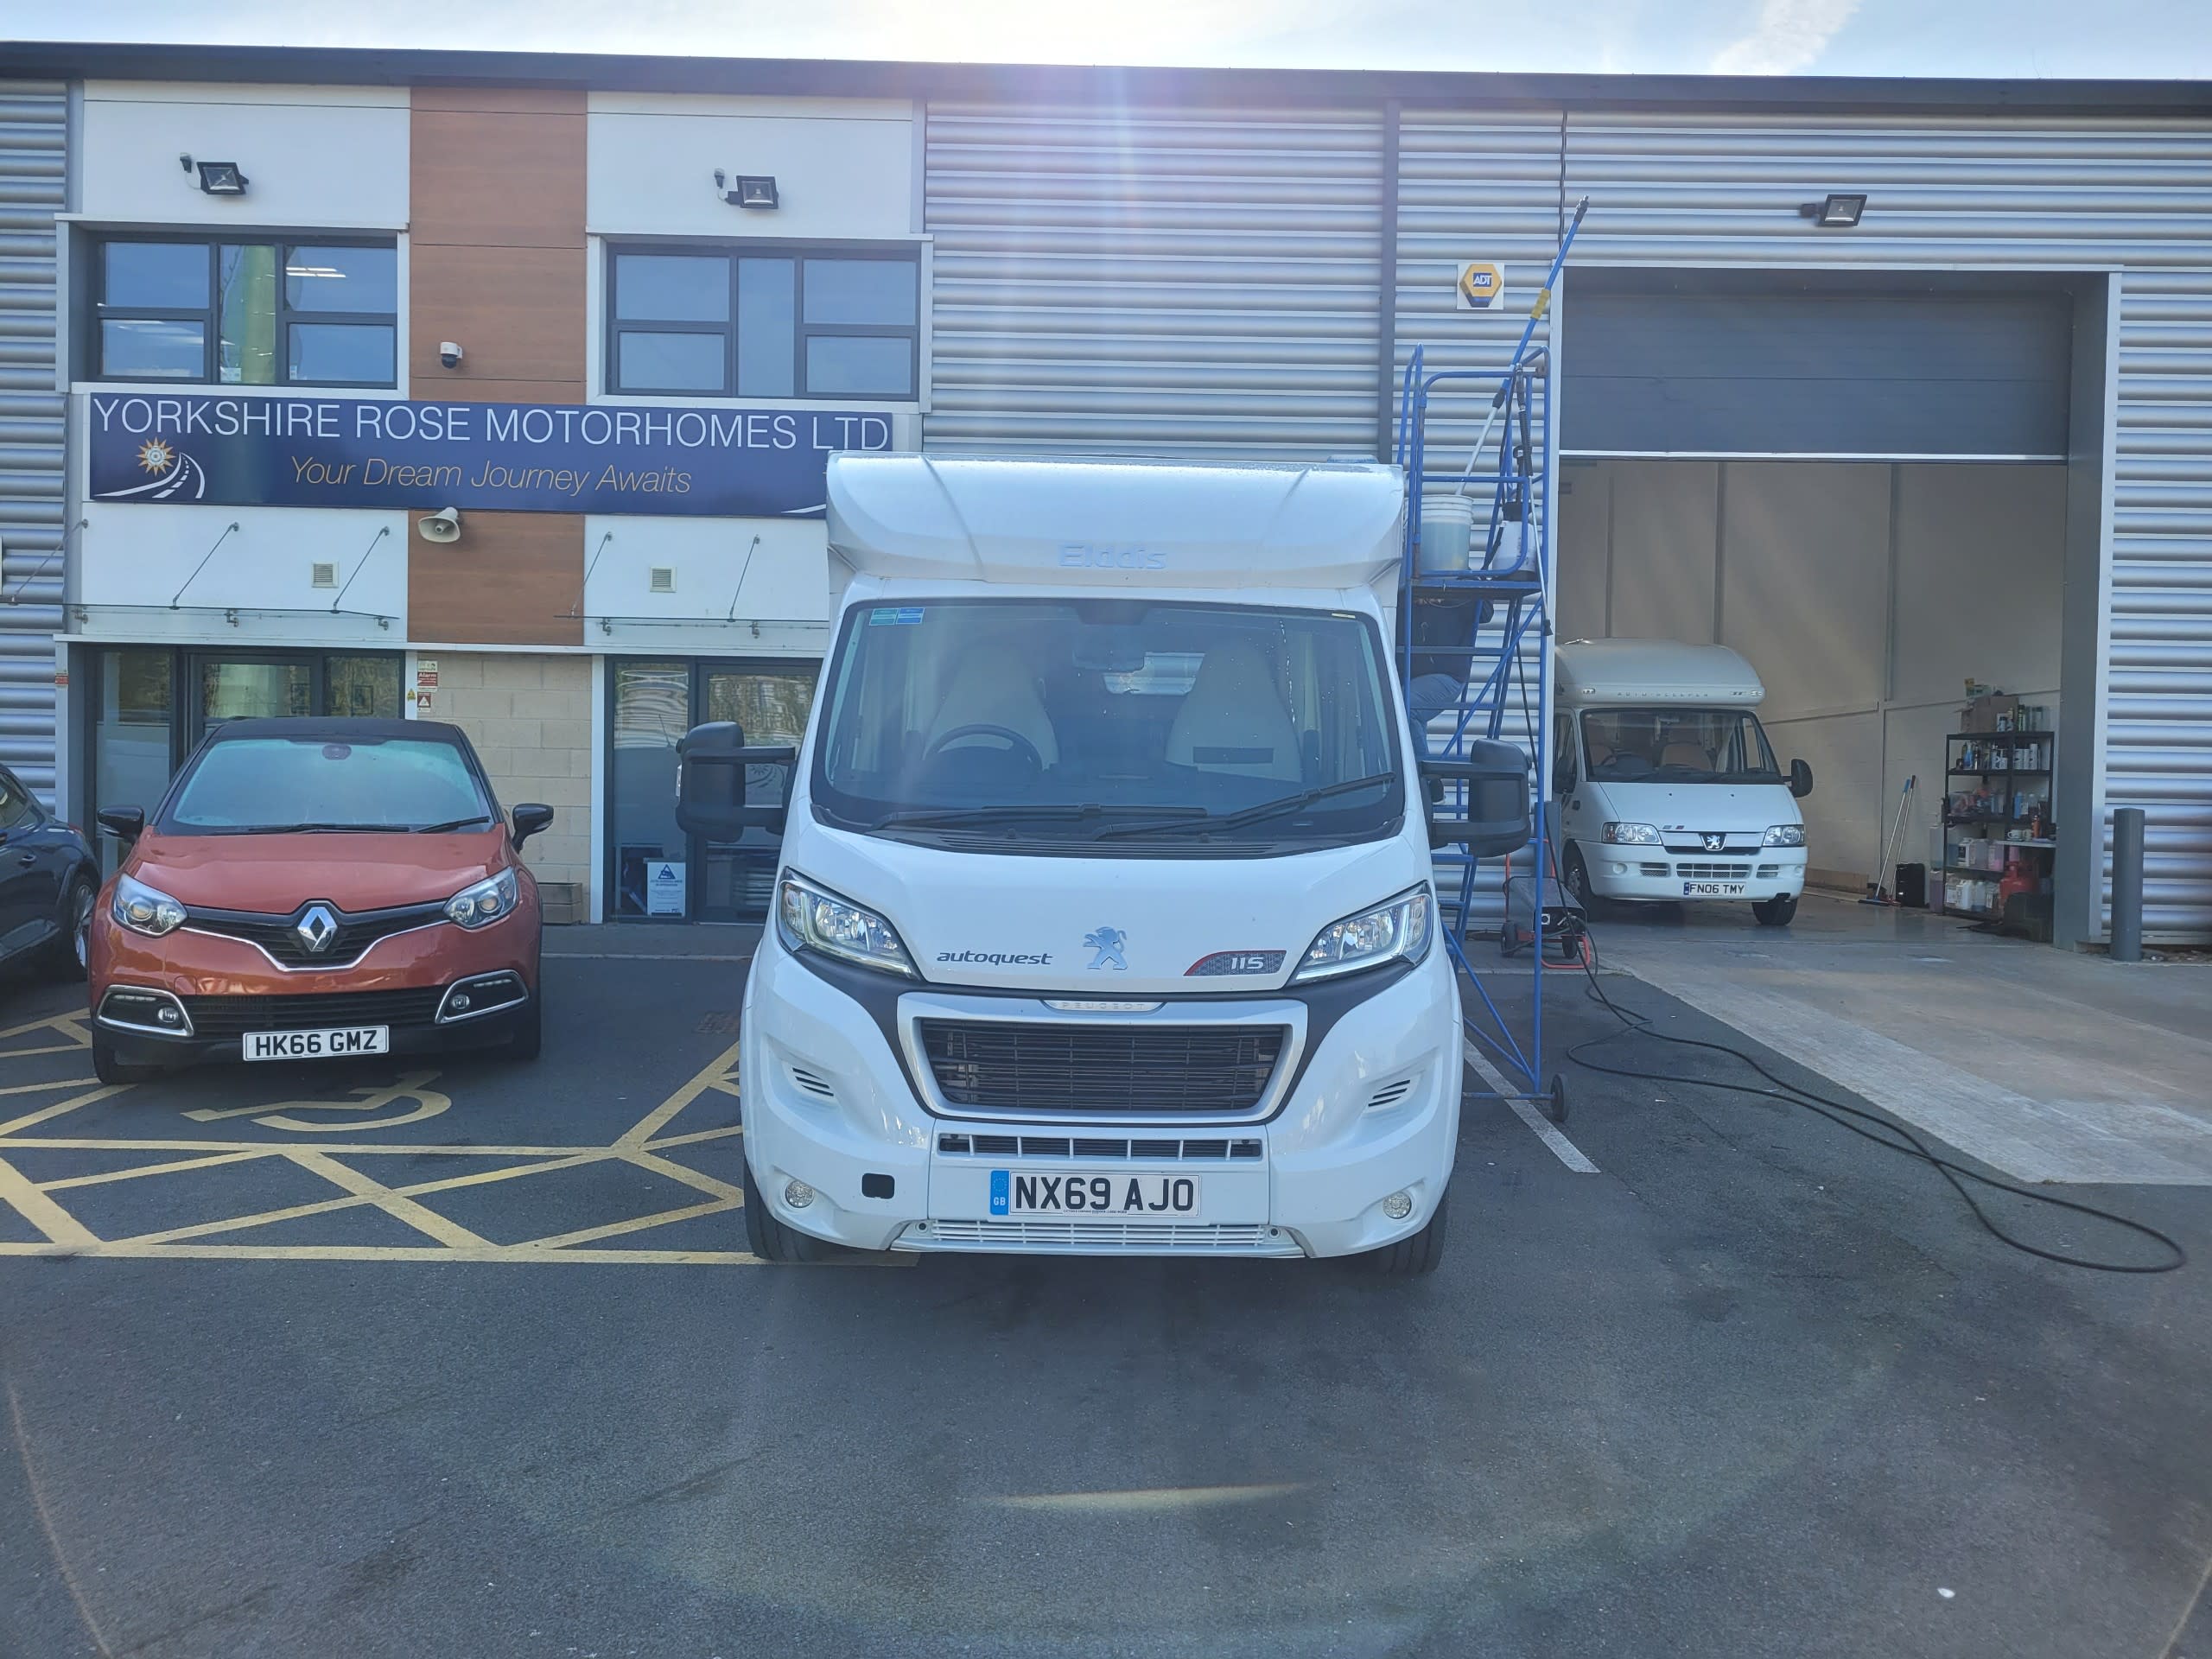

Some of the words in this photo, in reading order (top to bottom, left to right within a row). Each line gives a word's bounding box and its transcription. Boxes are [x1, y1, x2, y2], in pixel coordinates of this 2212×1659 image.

[1473, 275, 1491, 285] ADT
[93, 398, 340, 437] YORKSHIRE
[356, 405, 471, 441] ROSE
[486, 409, 797, 449] MOTORHOMES
[812, 416, 888, 450] LTD
[291, 455, 357, 485] Your
[364, 458, 462, 486] Dream
[471, 460, 591, 497] Journey
[594, 464, 691, 493] Awaits
[1689, 884, 1719, 893] FN06
[1723, 885, 1745, 894] TMY
[937, 950, 1054, 966] autoquest
[255, 1033, 322, 1057] HK66
[329, 1029, 378, 1052] GMZ
[993, 1196, 1006, 1206] GB
[1015, 1176, 1111, 1211] NX69
[1123, 1178, 1194, 1211] AJO
